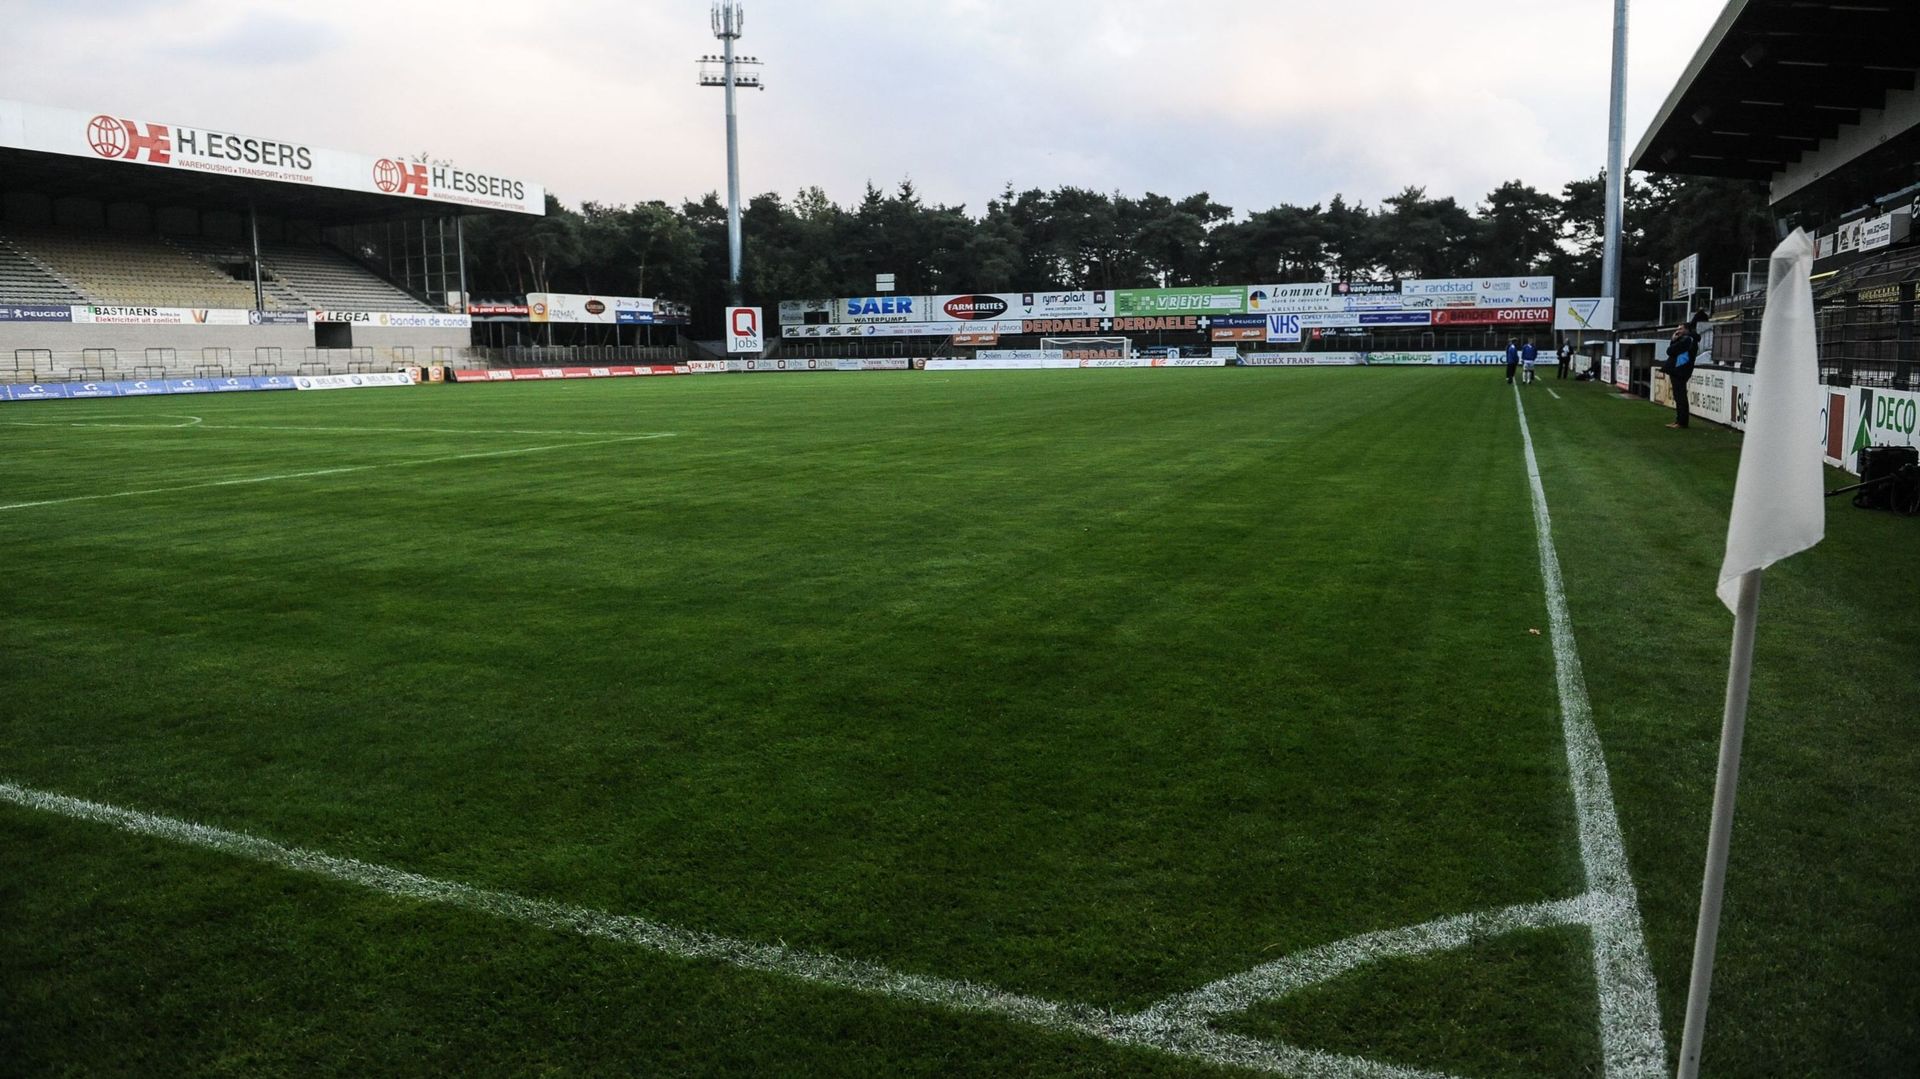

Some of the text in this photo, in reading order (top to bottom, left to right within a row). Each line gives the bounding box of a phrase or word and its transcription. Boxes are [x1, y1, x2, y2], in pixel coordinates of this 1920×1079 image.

[177, 128, 312, 170] H.ESSERS
[178, 160, 232, 173] WAREHOUSING
[238, 167, 278, 178] TRANSPORT
[433, 167, 524, 200] H.ESSERS
[1273, 285, 1329, 297] Lommel
[1425, 282, 1473, 292] randstad
[848, 296, 912, 315] SAER
[975, 302, 1004, 310] FRITES
[1158, 295, 1211, 308] VREYS
[95, 307, 158, 317] BASTIAENS
[328, 312, 370, 322] LEGEA
[1497, 309, 1549, 320] FONTEYN
[390, 314, 426, 326] banden
[429, 315, 440, 326] de
[733, 309, 757, 337] Q
[1023, 318, 1100, 333] DERDAELE
[1113, 316, 1197, 330] DERDAELE
[1269, 315, 1299, 334] VHS
[733, 338, 758, 351] Jobs
[1252, 357, 1283, 365] LUYCKX
[1876, 395, 1916, 434] DECO
